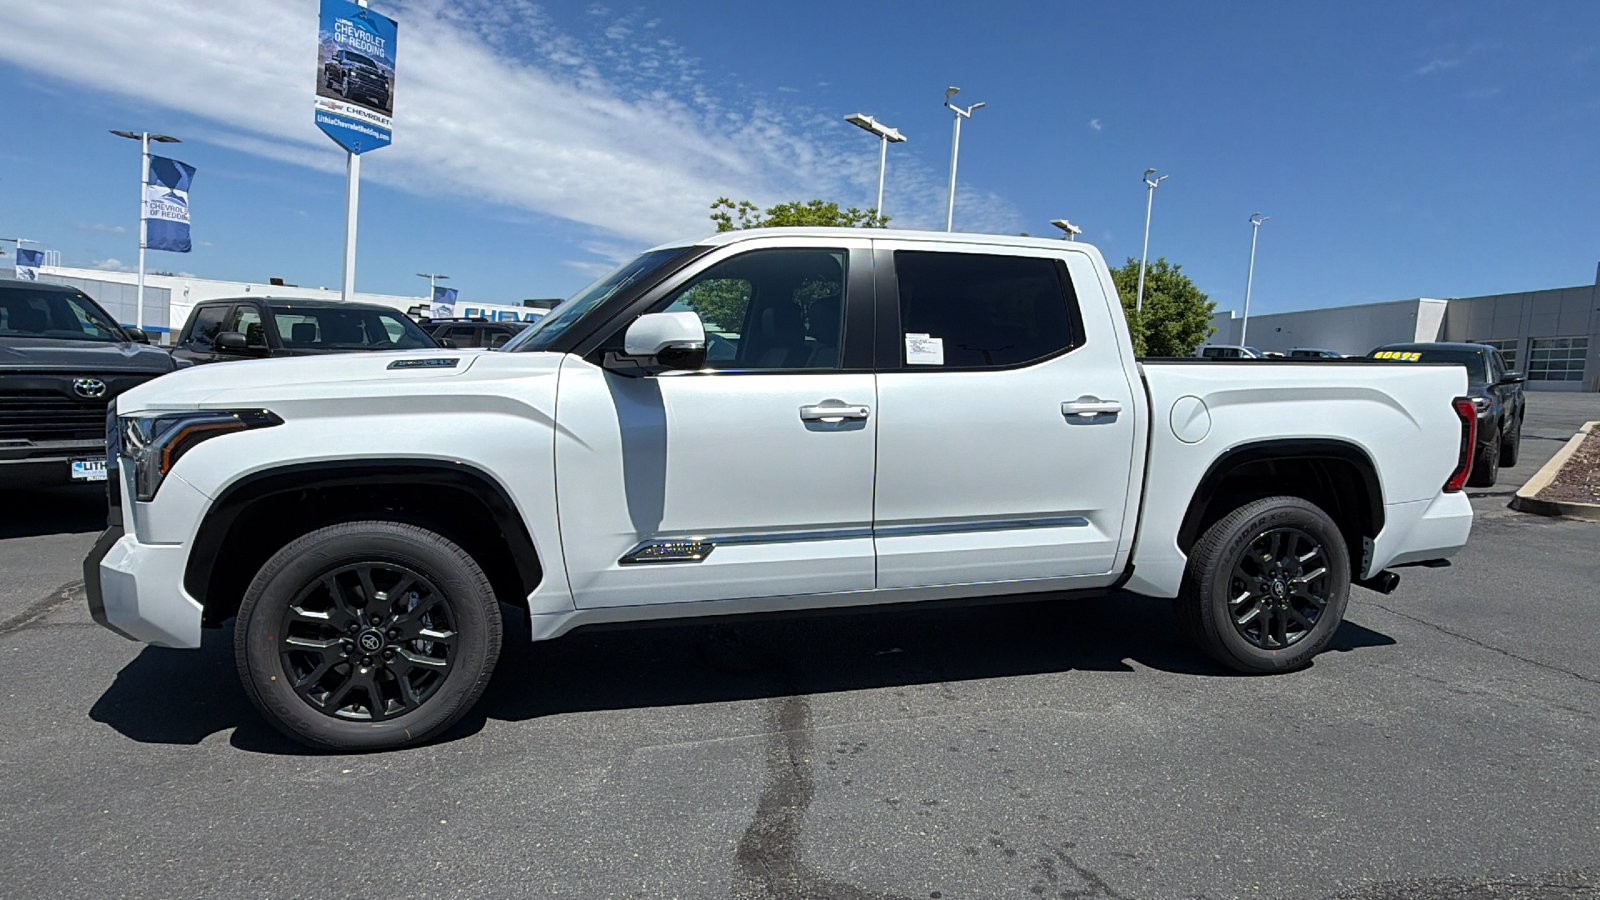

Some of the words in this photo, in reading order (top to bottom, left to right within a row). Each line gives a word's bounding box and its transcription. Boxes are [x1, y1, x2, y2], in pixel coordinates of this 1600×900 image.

[334, 22, 385, 48] CHEVROLET
[334, 32, 347, 43] OF
[349, 36, 385, 58] REDDING
[346, 106, 390, 126] CHEVROLET
[151, 203, 188, 213] CHEVROLE
[161, 211, 189, 220] REDDIN
[83, 461, 107, 470] LITH
